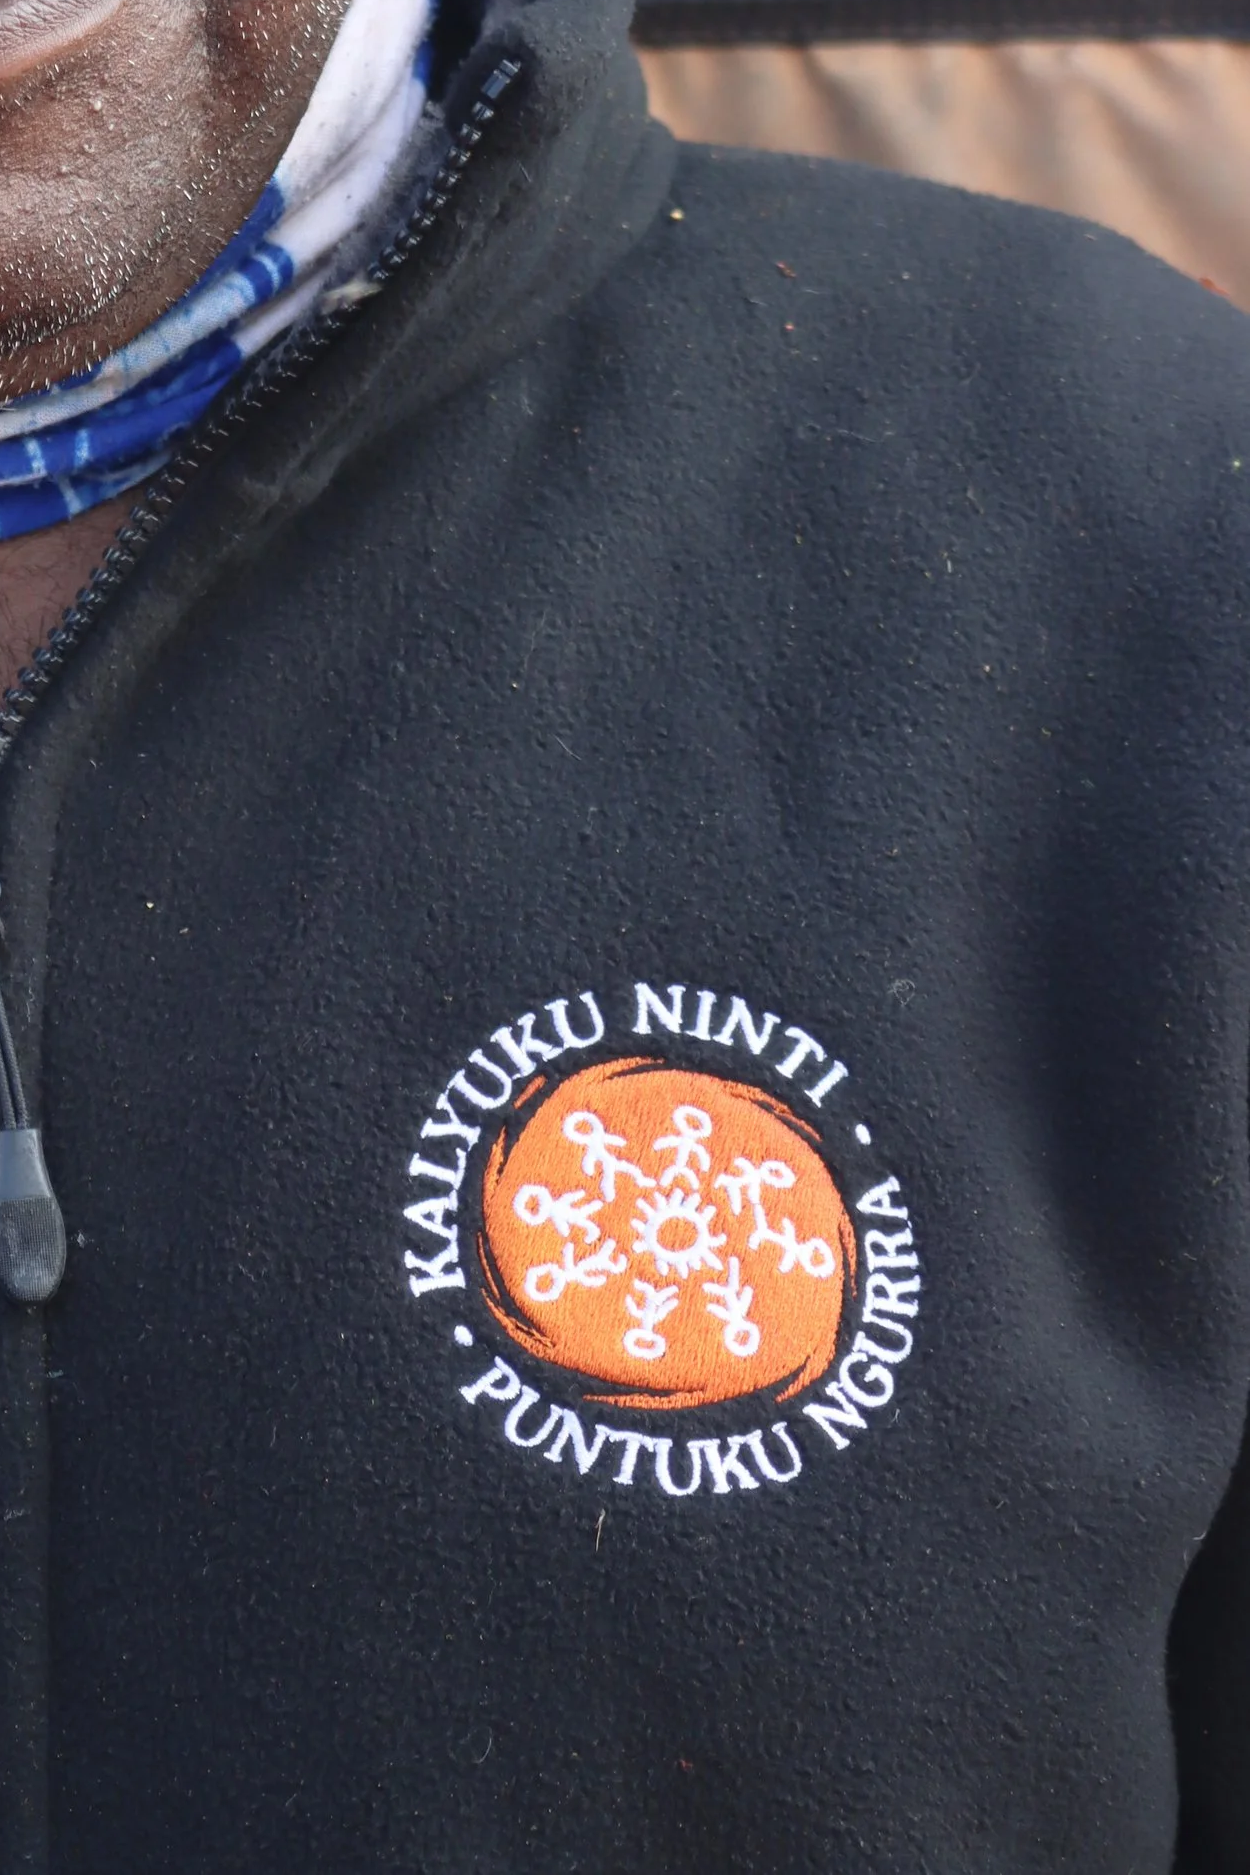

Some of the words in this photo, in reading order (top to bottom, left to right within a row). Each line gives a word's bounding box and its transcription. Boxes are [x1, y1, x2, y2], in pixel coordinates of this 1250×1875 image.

[403, 991, 605, 1298] KALYUKU
[632, 982, 849, 1108] NINTI
[459, 1356, 803, 1497] PUNTUKU
[801, 1176, 922, 1451] NGURRA
